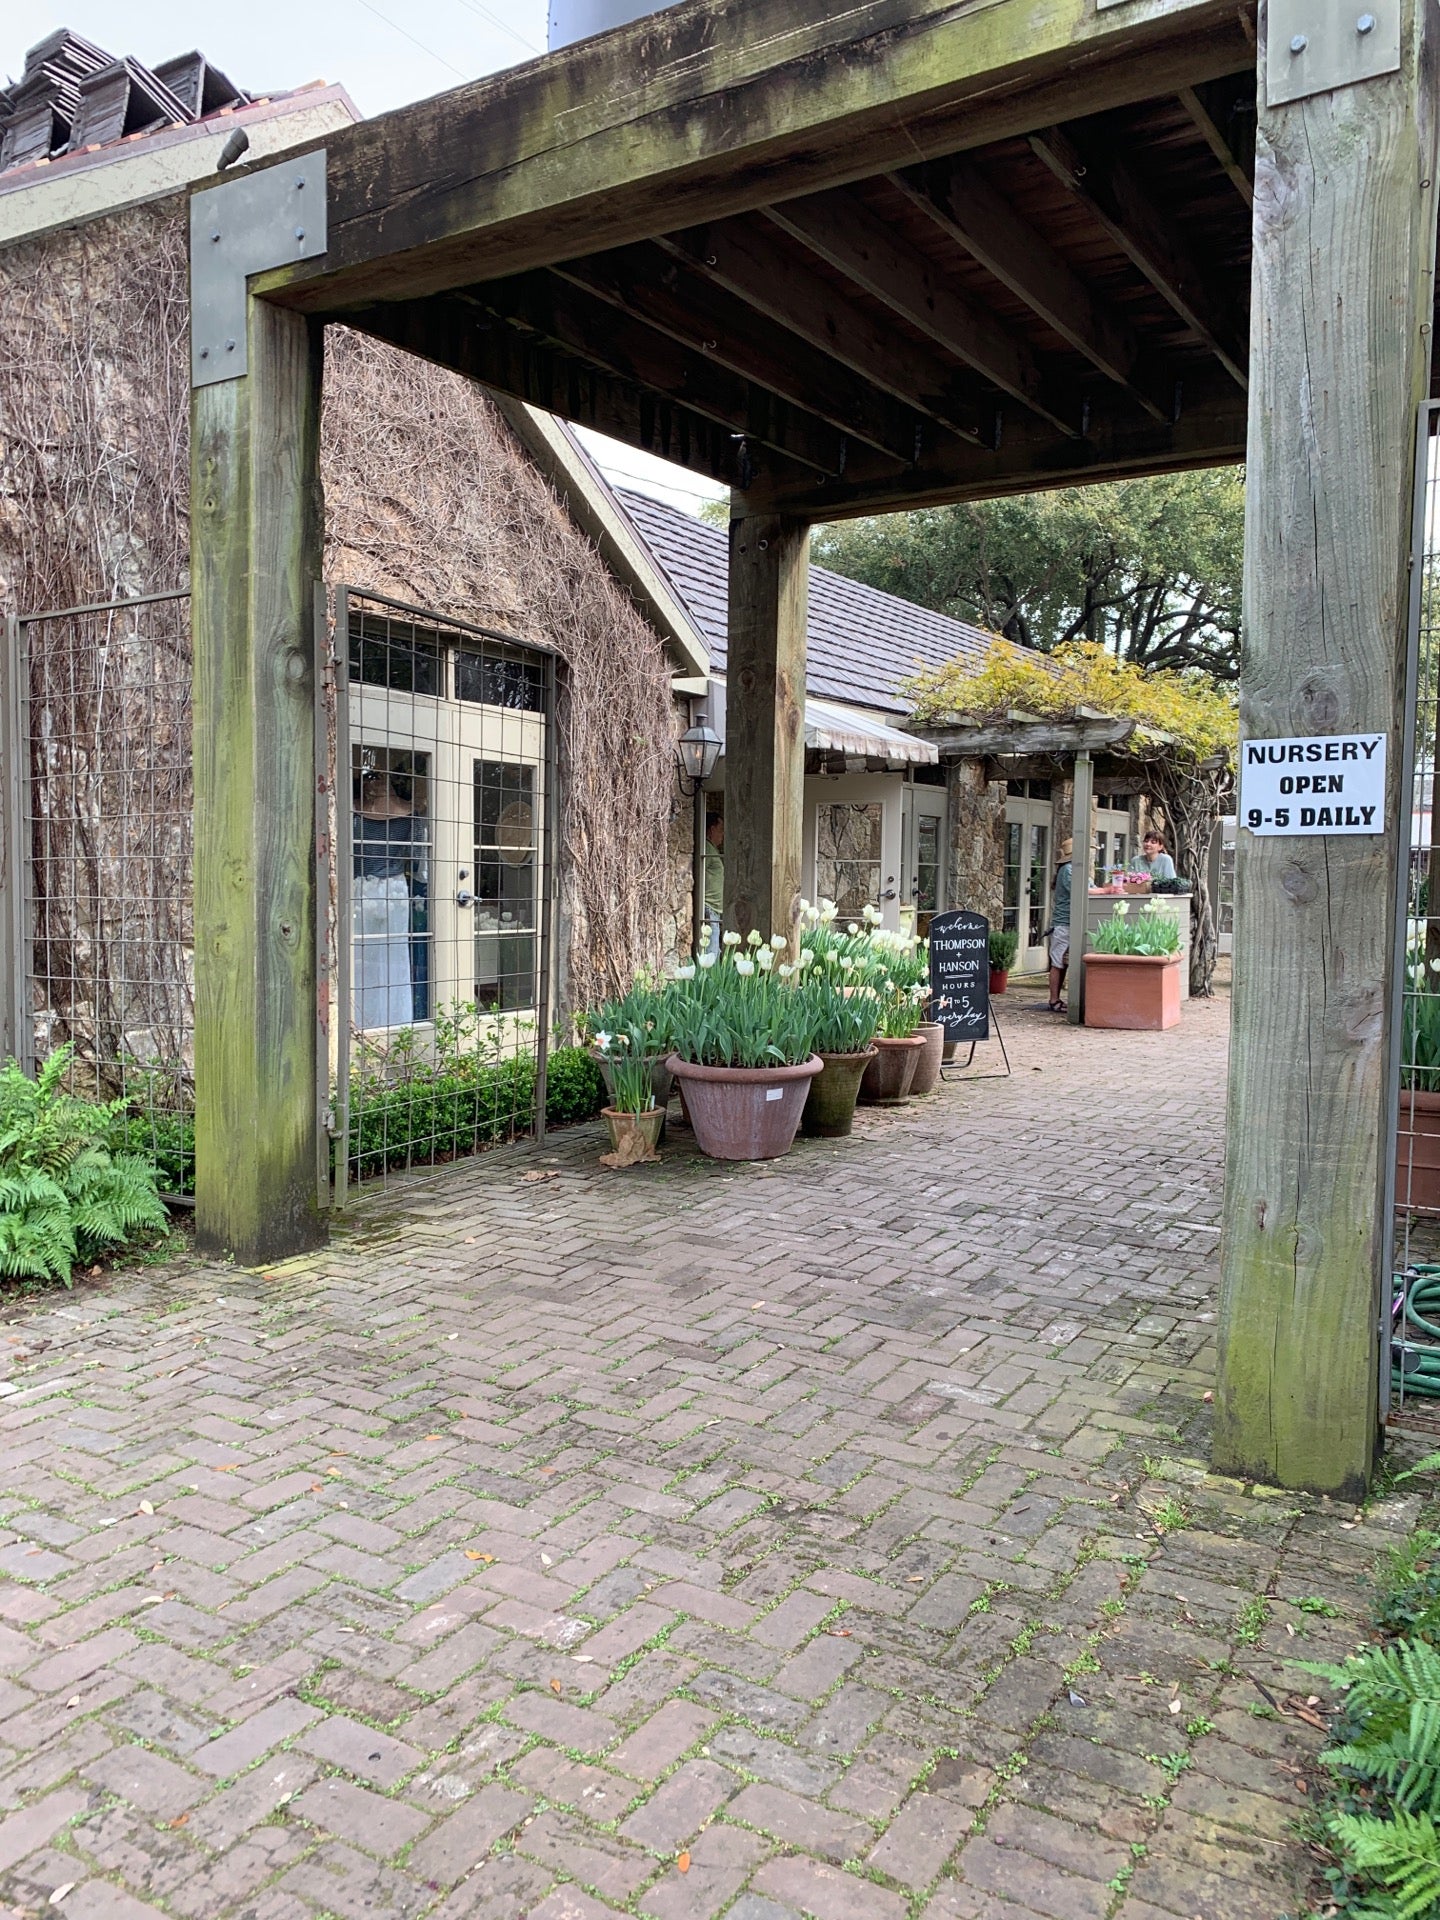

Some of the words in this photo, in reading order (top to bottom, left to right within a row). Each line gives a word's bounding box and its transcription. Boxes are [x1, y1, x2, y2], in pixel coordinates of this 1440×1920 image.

[1248, 741, 1379, 764] NURSERY
[1280, 774, 1344, 794] OPEN
[1248, 808, 1290, 828] 9-5
[1300, 806, 1376, 826] DAILY
[935, 917, 985, 934] welcome
[933, 938, 986, 951] THOMPSON
[939, 960, 980, 973] HANSON
[942, 981, 976, 990] HOURS
[962, 995, 970, 1008] 5
